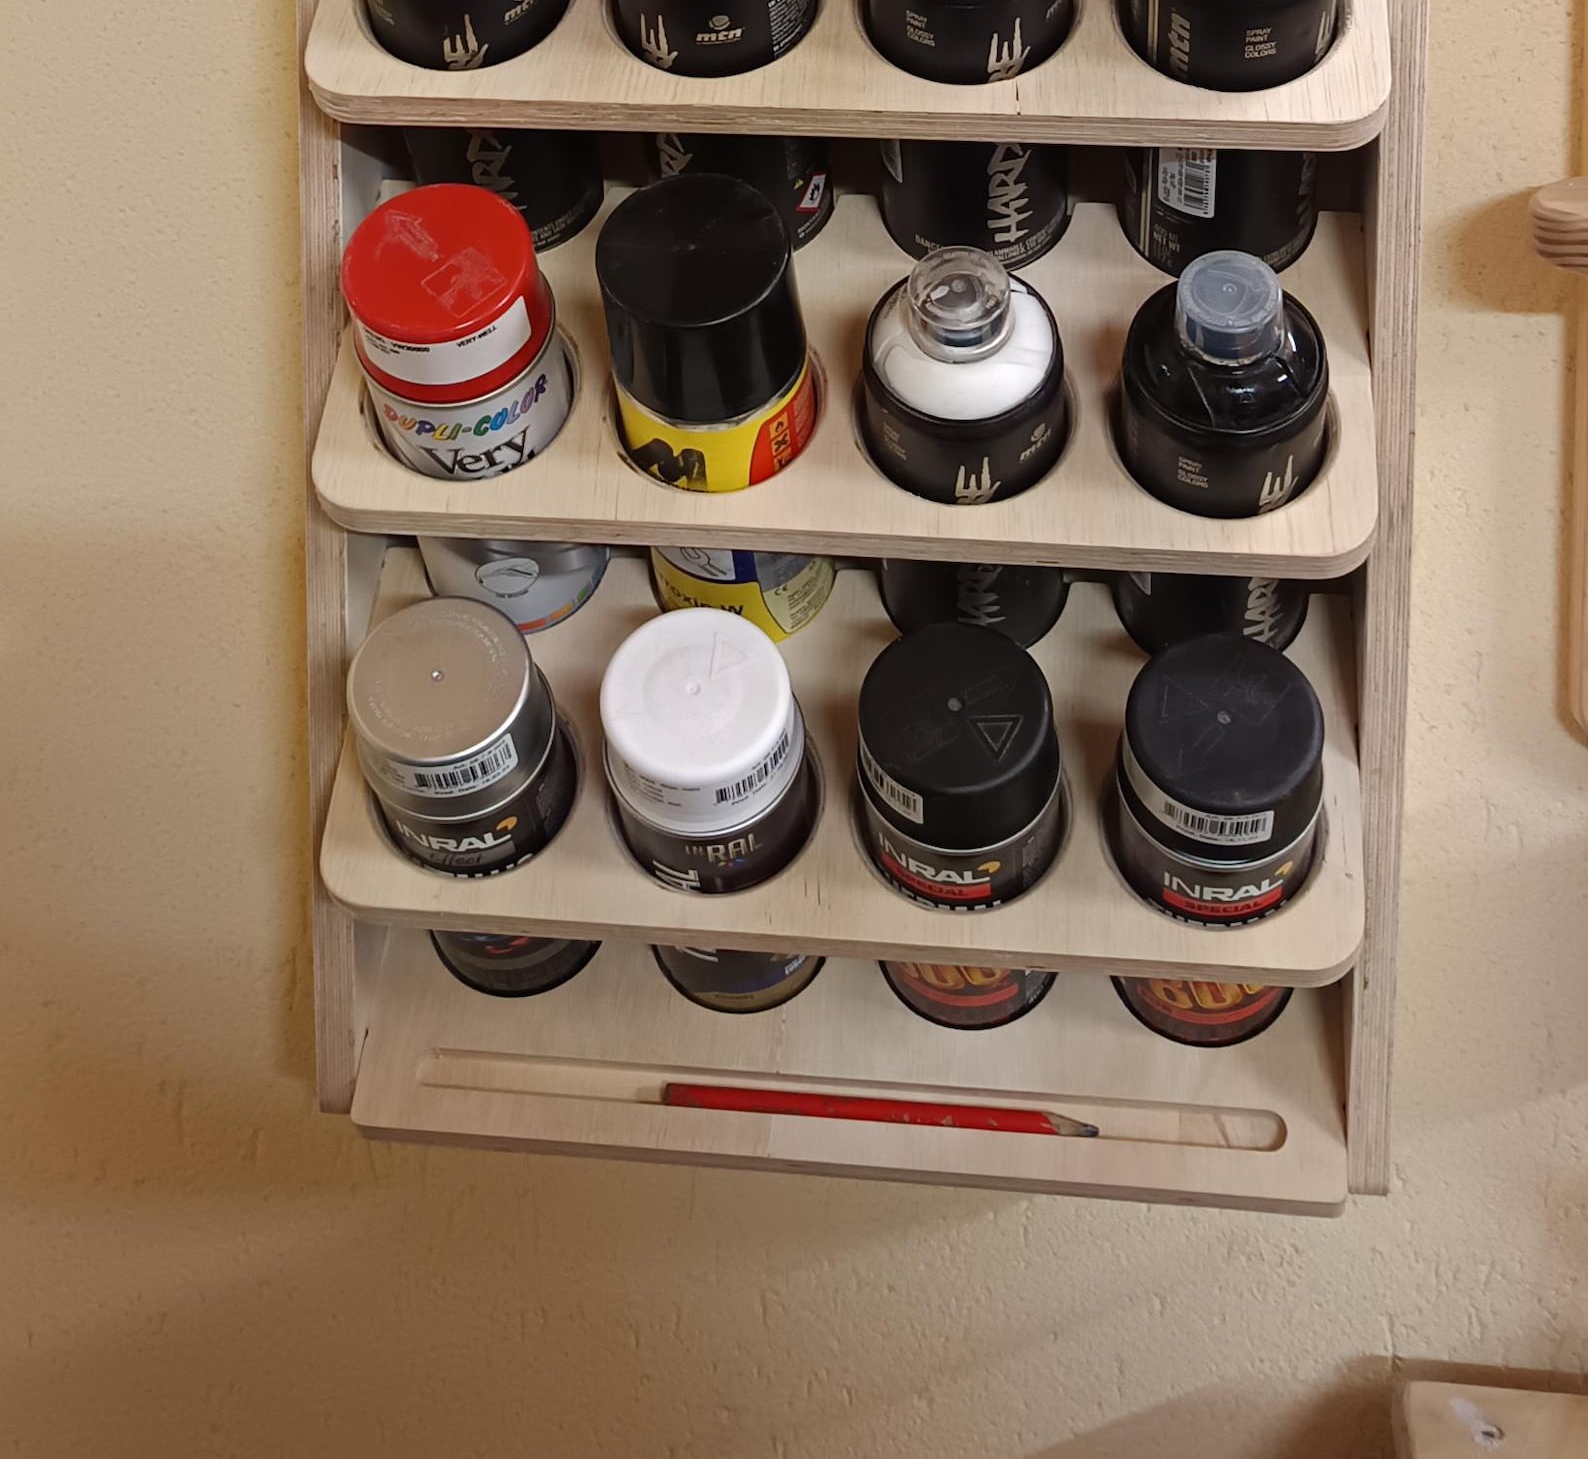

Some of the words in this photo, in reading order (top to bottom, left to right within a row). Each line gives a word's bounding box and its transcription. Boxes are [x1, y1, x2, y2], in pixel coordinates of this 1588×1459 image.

[384, 373, 547, 441] DUPLI-COLOR
[419, 426, 531, 476] Very
[397, 818, 512, 852] INRAL
[879, 831, 990, 885] INRAL
[1163, 871, 1284, 902] INRAL
